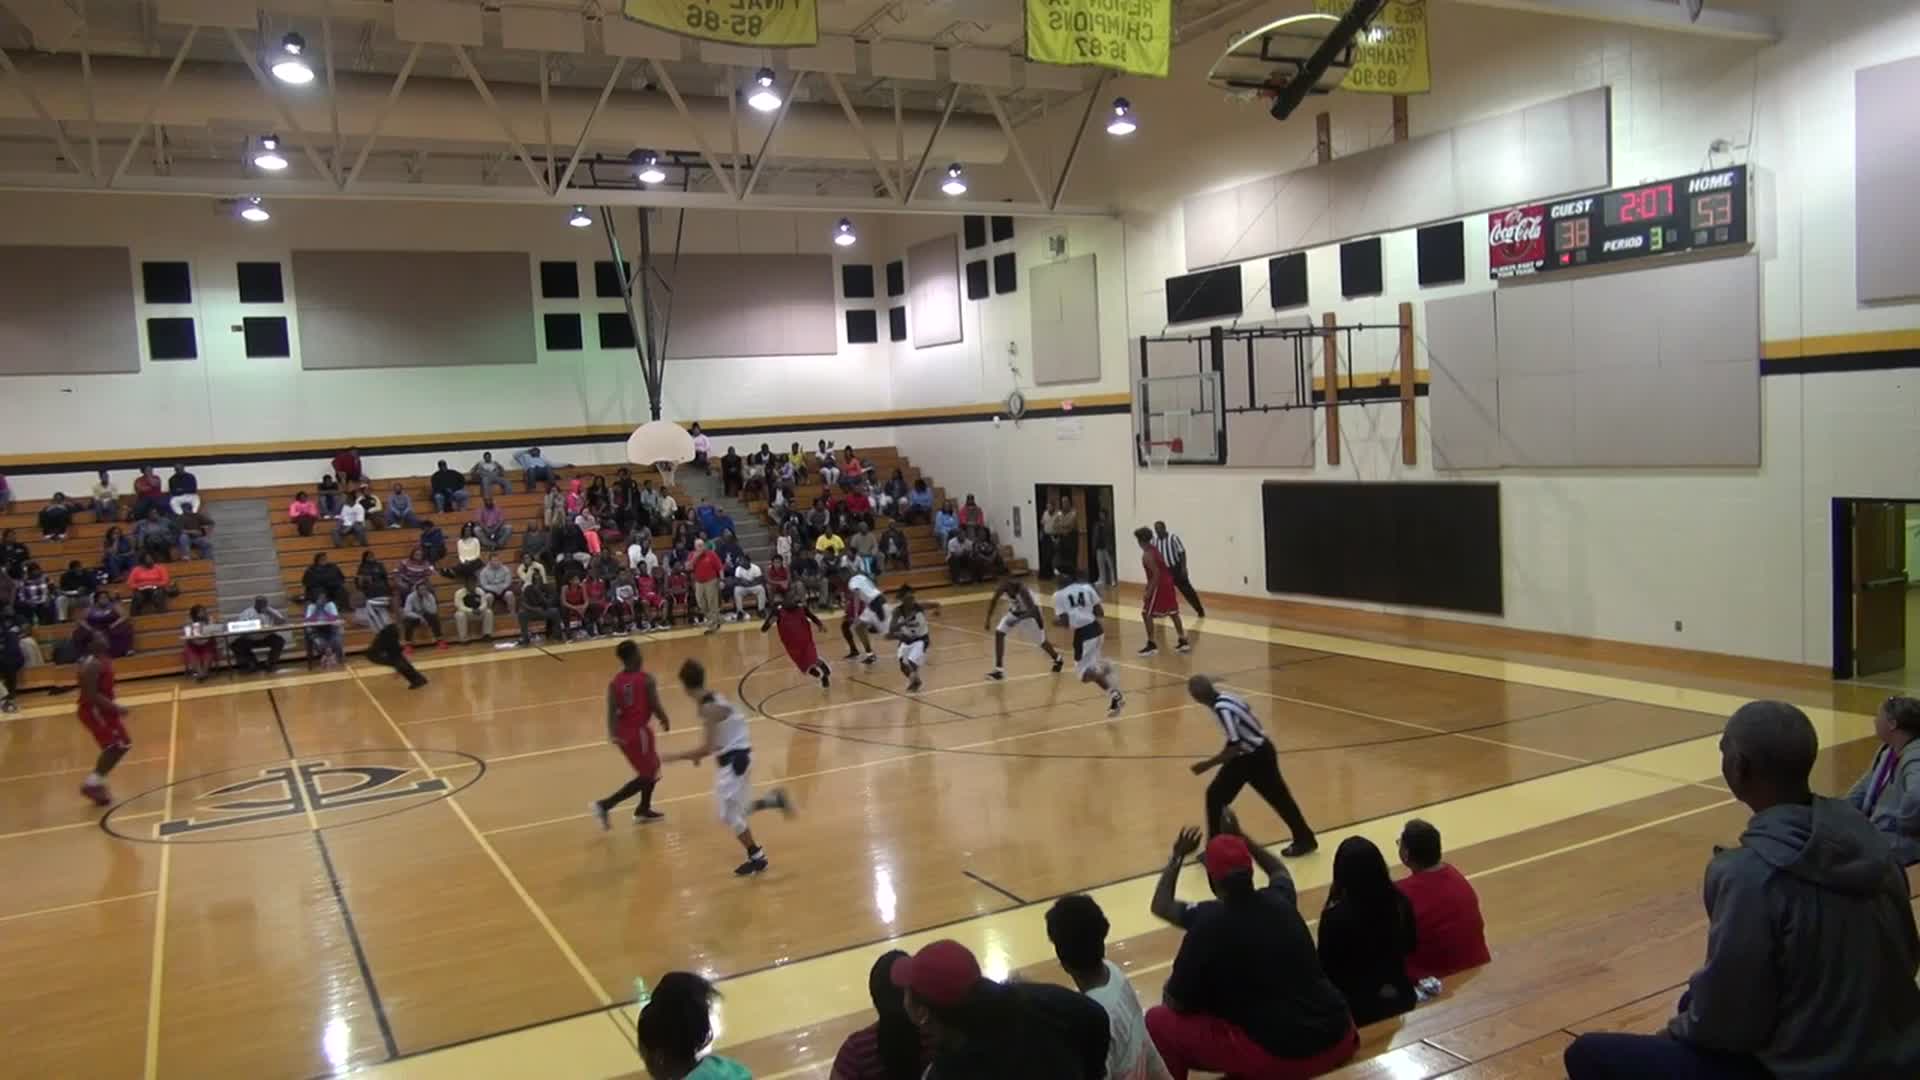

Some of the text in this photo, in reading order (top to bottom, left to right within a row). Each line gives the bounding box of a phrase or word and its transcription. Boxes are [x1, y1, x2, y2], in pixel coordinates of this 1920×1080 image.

[1688, 172, 1734, 193] HOME
[1551, 199, 1593, 219] GUEST
[1620, 183, 1676, 224] 2:07
[1698, 192, 1733, 228] 53
[1561, 219, 1590, 250] 38
[1603, 235, 1644, 251] PERIOD
[1650, 227, 1663, 251] 3
[1067, 592, 1086, 608] 14
